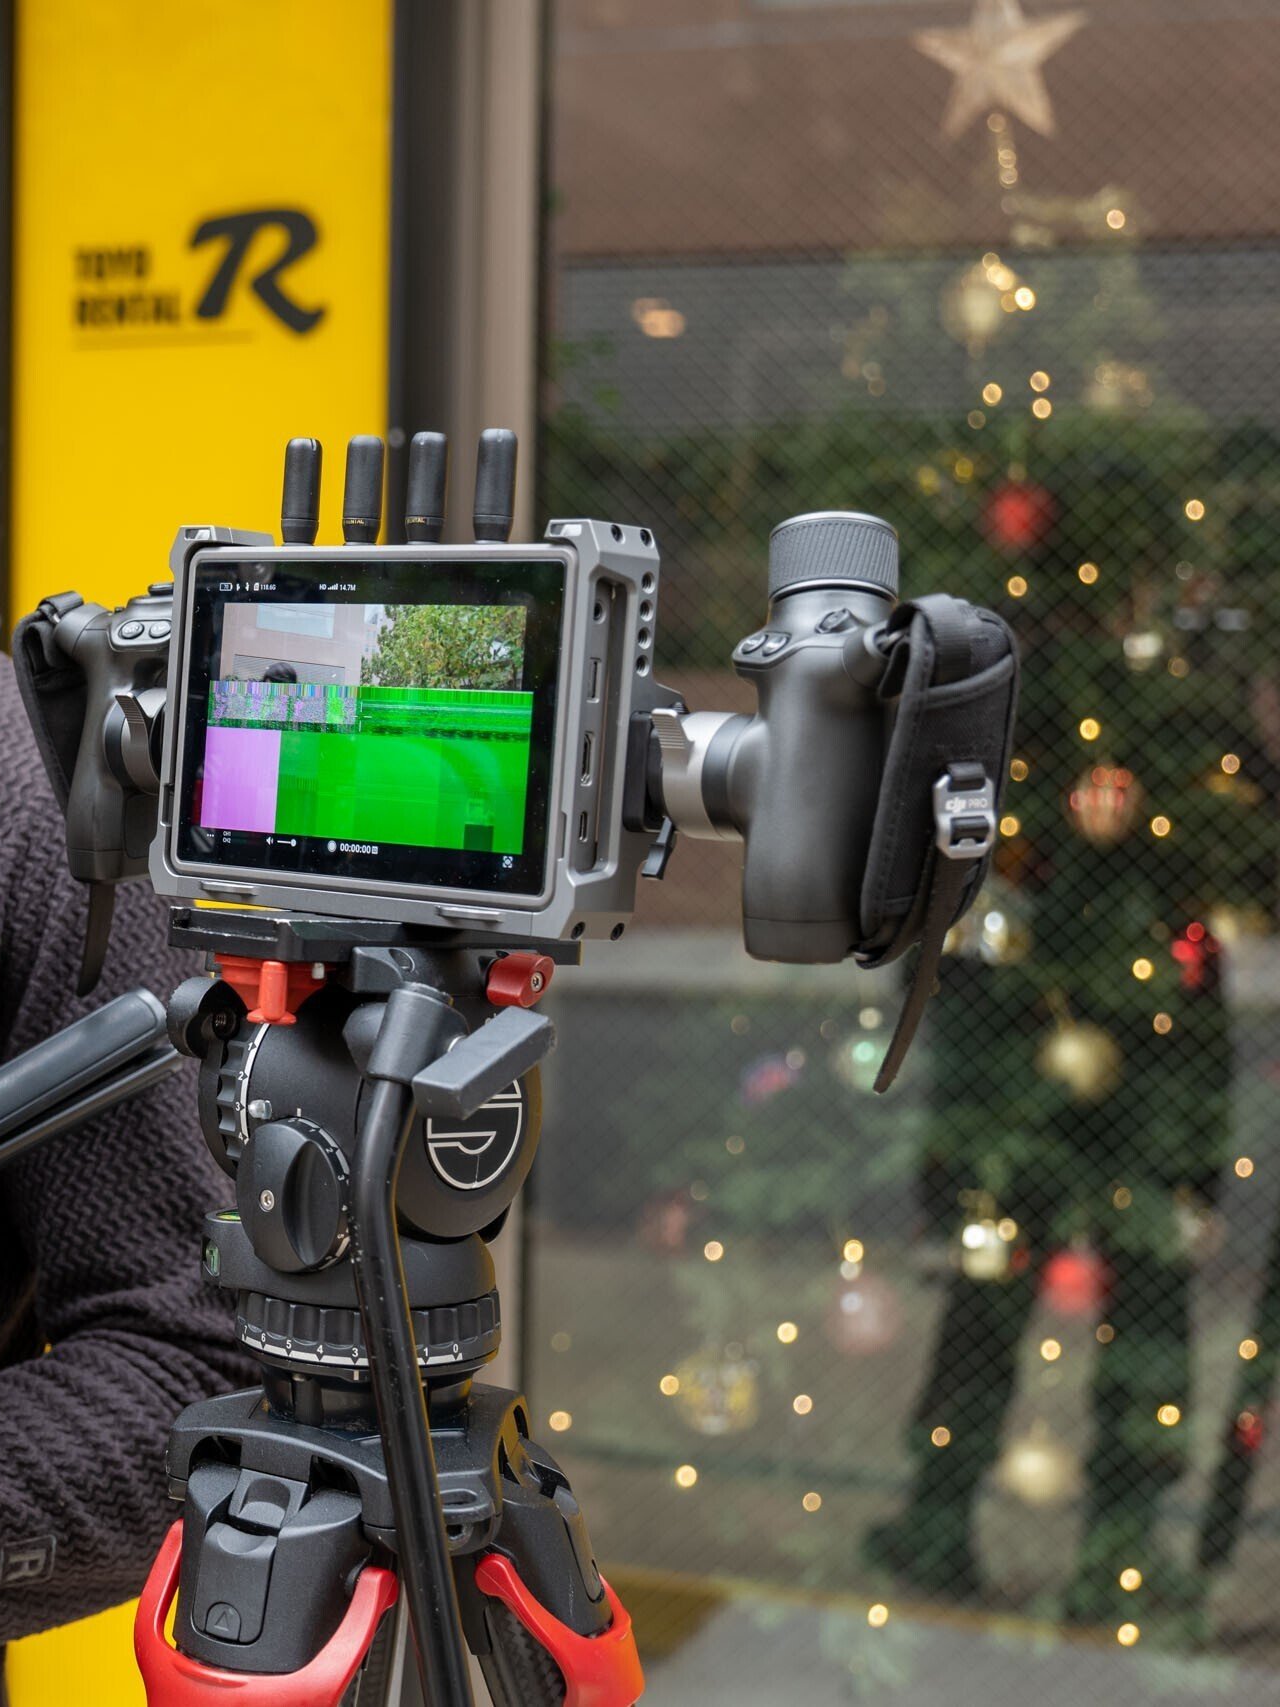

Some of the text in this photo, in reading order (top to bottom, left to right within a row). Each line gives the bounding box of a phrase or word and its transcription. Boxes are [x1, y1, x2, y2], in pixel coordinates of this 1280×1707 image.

[190, 207, 328, 336] R
[968, 799, 988, 808] PRO
[339, 842, 371, 854] 00:00:00
[238, 1071, 244, 1080] 2
[235, 1102, 241, 1111] 3
[261, 1333, 266, 1343] 6
[286, 1340, 292, 1349] 5
[317, 1345, 323, 1354] 4
[352, 1348, 358, 1357] 3
[453, 1343, 459, 1353] 0
